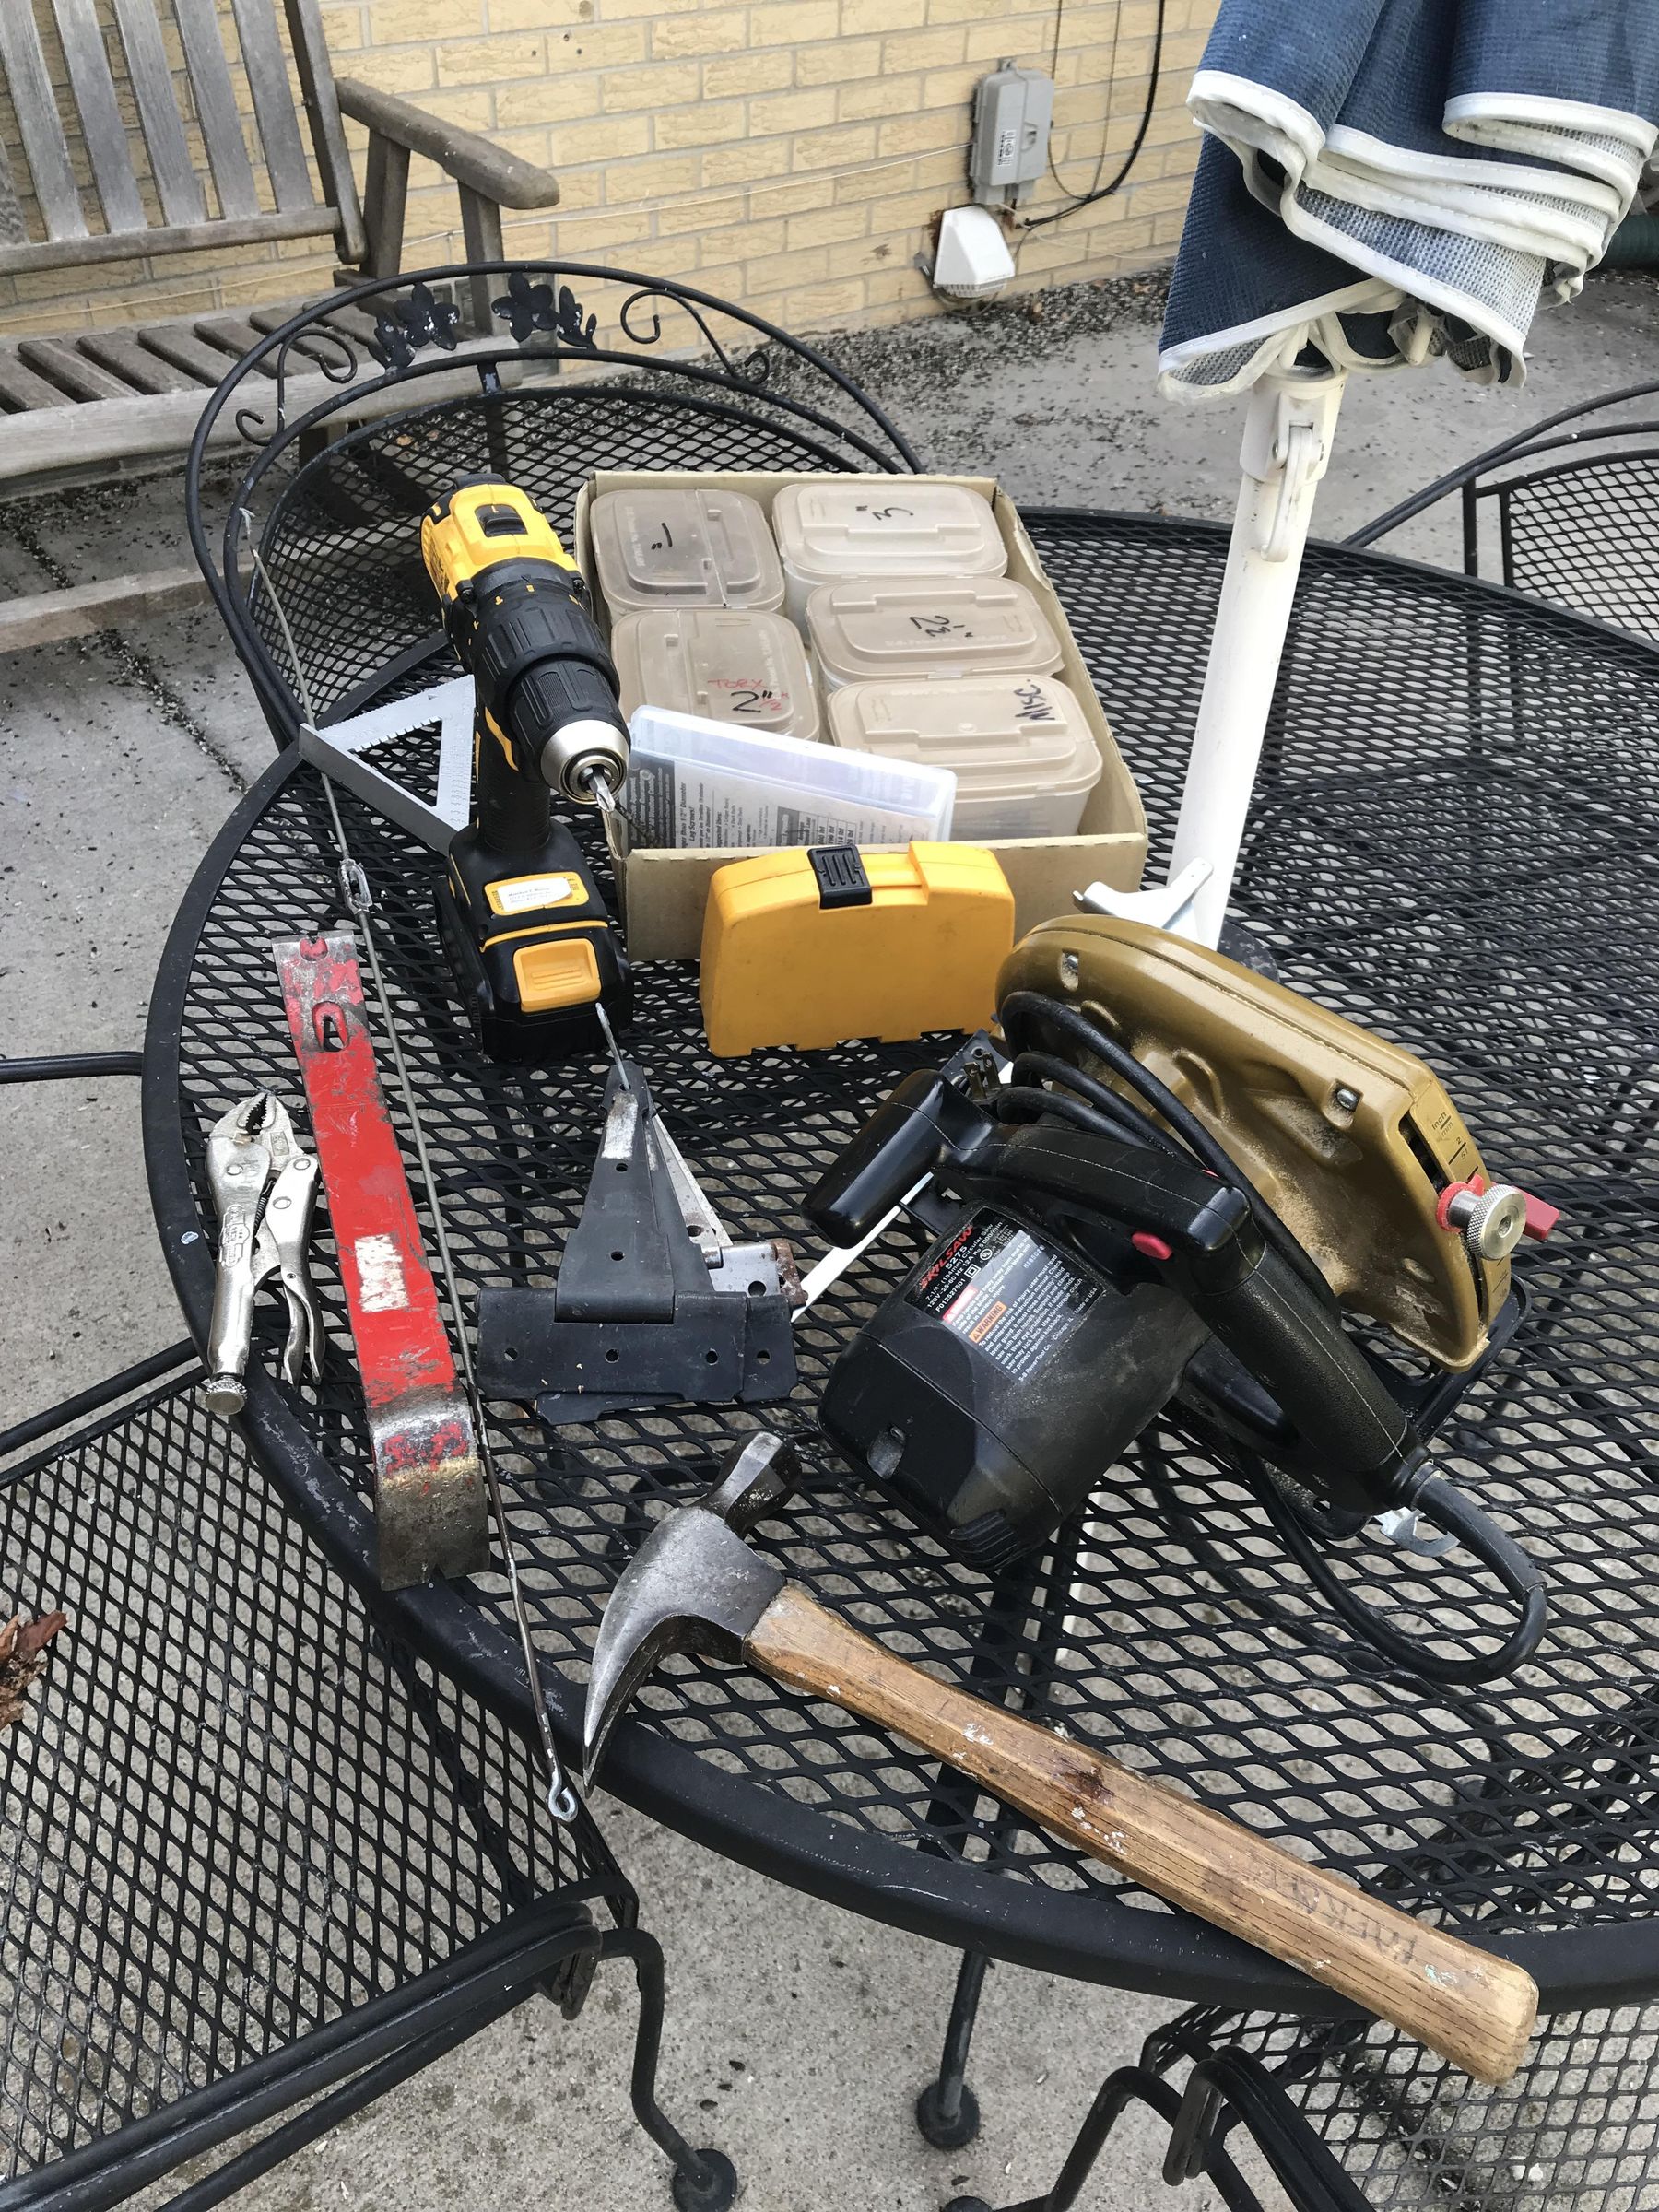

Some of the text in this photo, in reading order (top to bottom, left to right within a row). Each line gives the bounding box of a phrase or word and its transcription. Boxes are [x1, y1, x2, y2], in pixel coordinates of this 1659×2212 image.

[946, 1245, 968, 1270] 5275
[956, 1267, 964, 1276] Hz
[963, 1255, 974, 1267] 12A
[962, 1236, 982, 1259] Circular
[982, 1223, 994, 1236] Saw
[976, 1304, 1003, 1335] WARNING
[984, 1324, 999, 1341] reduce
[998, 1316, 1006, 1324] the
[1005, 1307, 1014, 1317] risk
[1029, 1277, 1039, 1288] user
[1038, 1265, 1049, 1277] must
[1047, 1254, 1057, 1266] read
[984, 1341, 994, 1351] and
[993, 1315, 1016, 1343] understand
[1014, 1291, 1036, 1316] instruction
[1049, 1259, 1062, 1275] Check
[990, 1342, 1002, 1356] lower
[1017, 1312, 1028, 1324] must
[1026, 1299, 1039, 1312] close
[1053, 1266, 1065, 1278] Hold
[995, 1349, 1005, 1360] saw
[1004, 1339, 1014, 1350] with
[1012, 1328, 1023, 1340] both
[1034, 1294, 1052, 1314] Support
[1049, 1285, 1059, 1296] and
[1057, 1271, 1071, 1287] clamp
[1006, 1359, 1016, 1370] saw
[1015, 1348, 1025, 1360] may
[1023, 1338, 1032, 1349] kick
[1041, 1316, 1051, 1327] Use
[1069, 1277, 1083, 1293] clutch
[1011, 1339, 1023, 1352] Wear
[1021, 1331, 1030, 1341] eye
[1052, 1289, 1065, 1303] blade
[1026, 1359, 1039, 1373] Power
[1036, 1349, 1046, 1360] Tool
[1075, 1301, 1086, 1314] Made
[1088, 1288, 1097, 1298] USA
[1016, 1351, 1032, 1370] protect
[1030, 1334, 1046, 1353] against
